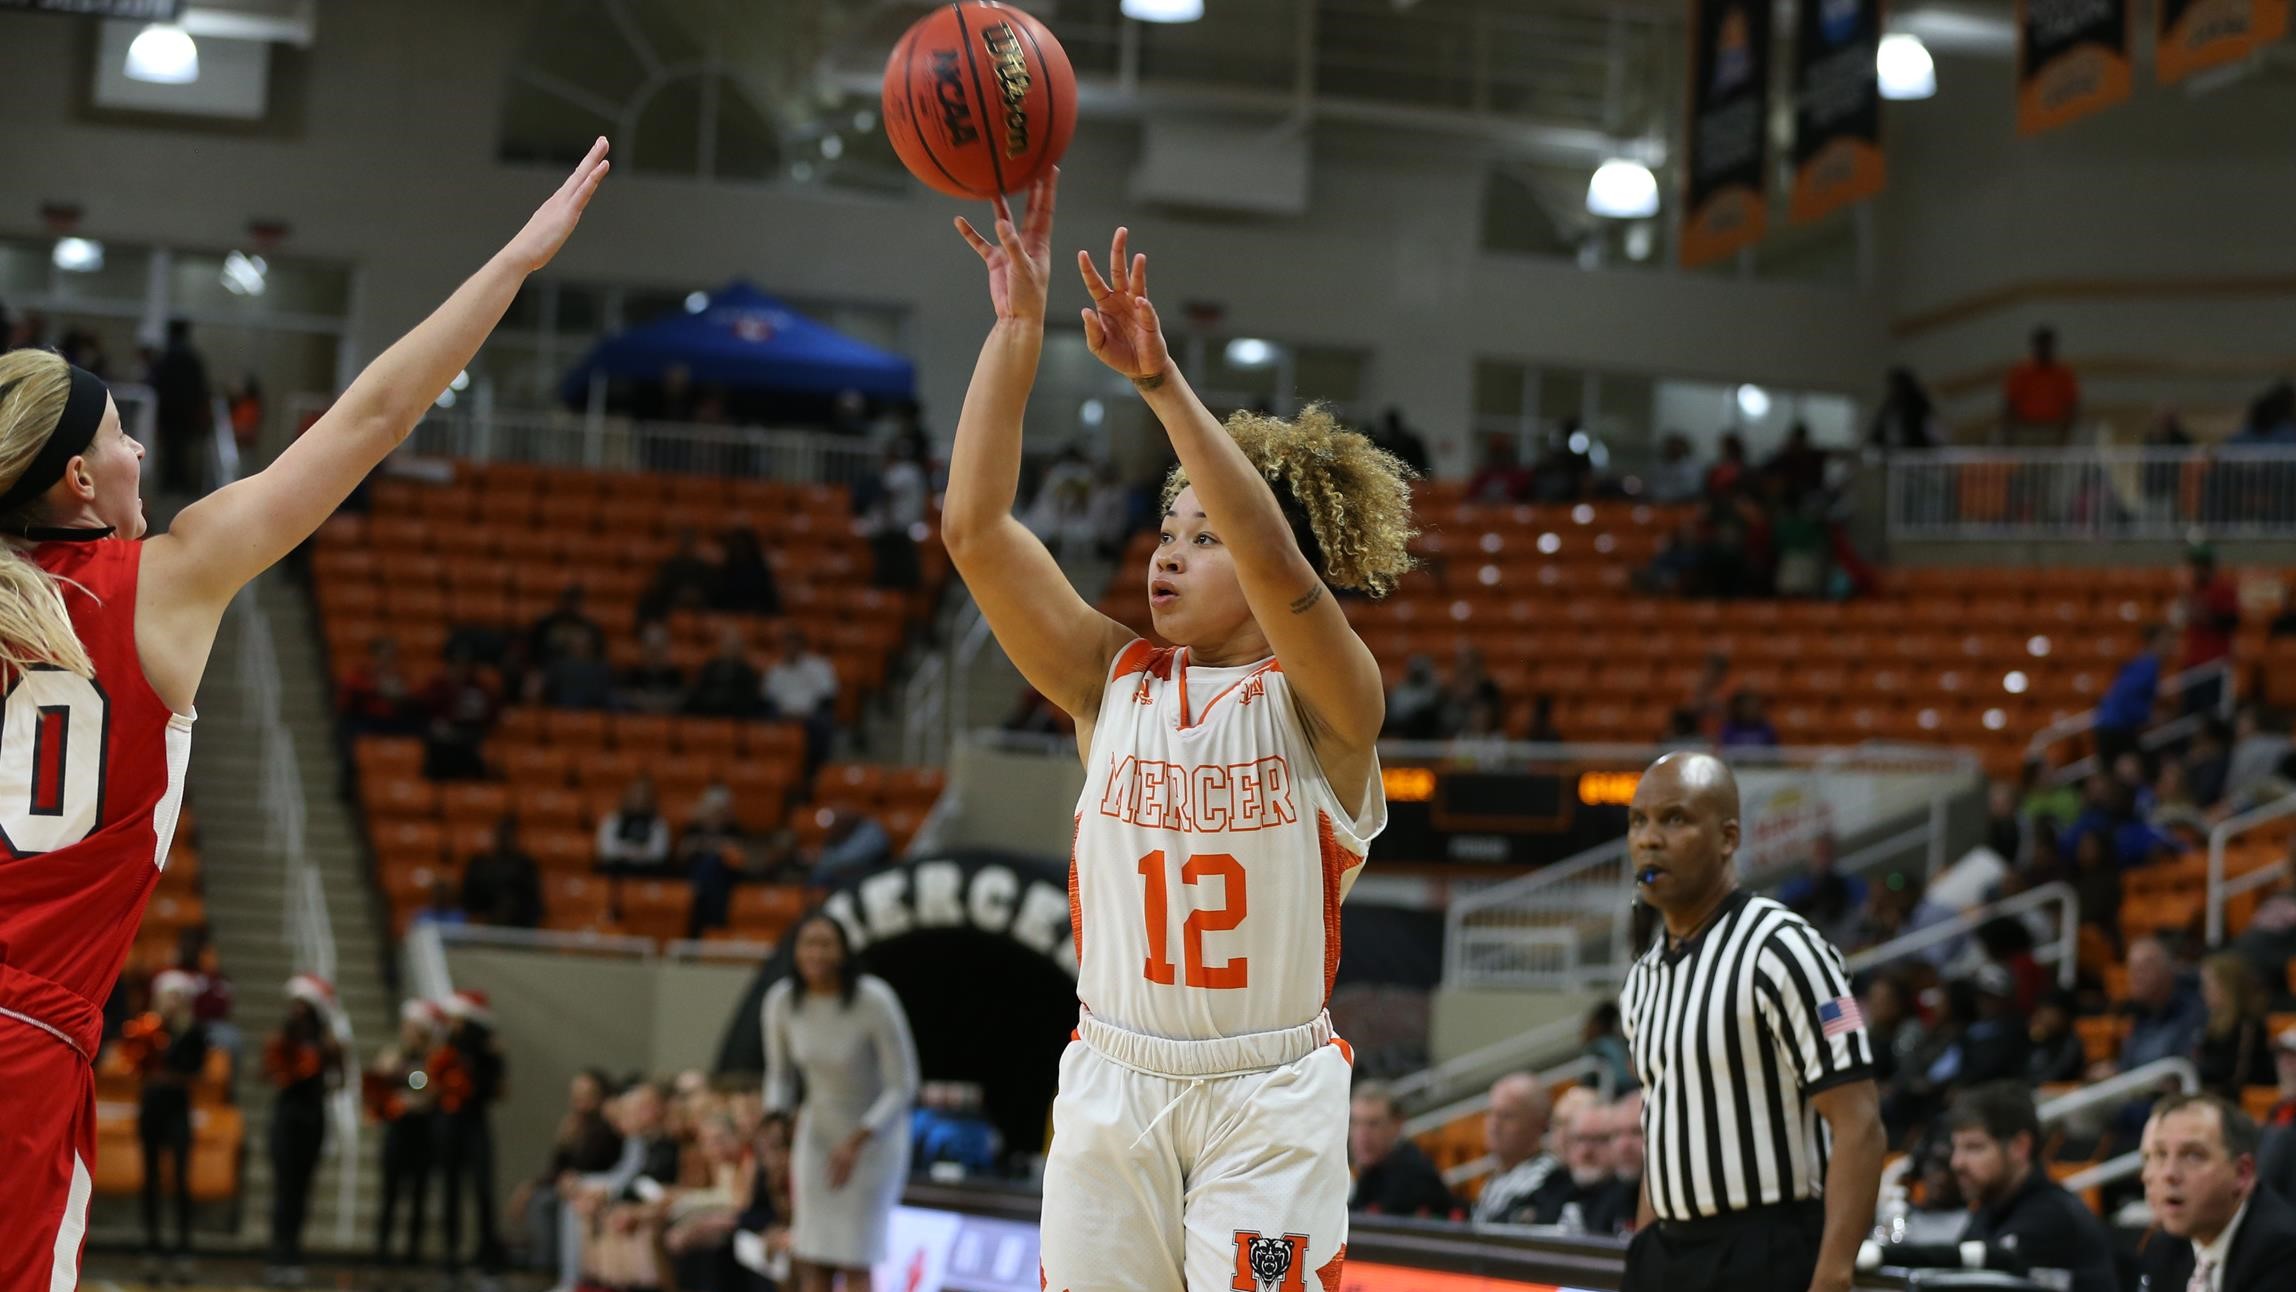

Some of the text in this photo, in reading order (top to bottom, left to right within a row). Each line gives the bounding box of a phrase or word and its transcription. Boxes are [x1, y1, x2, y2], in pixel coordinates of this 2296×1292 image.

[932, 48, 980, 147] NCAA
[1100, 753, 1297, 833] MERCER
[824, 860, 1081, 976] ERCE
[1138, 849, 1248, 989] 12
